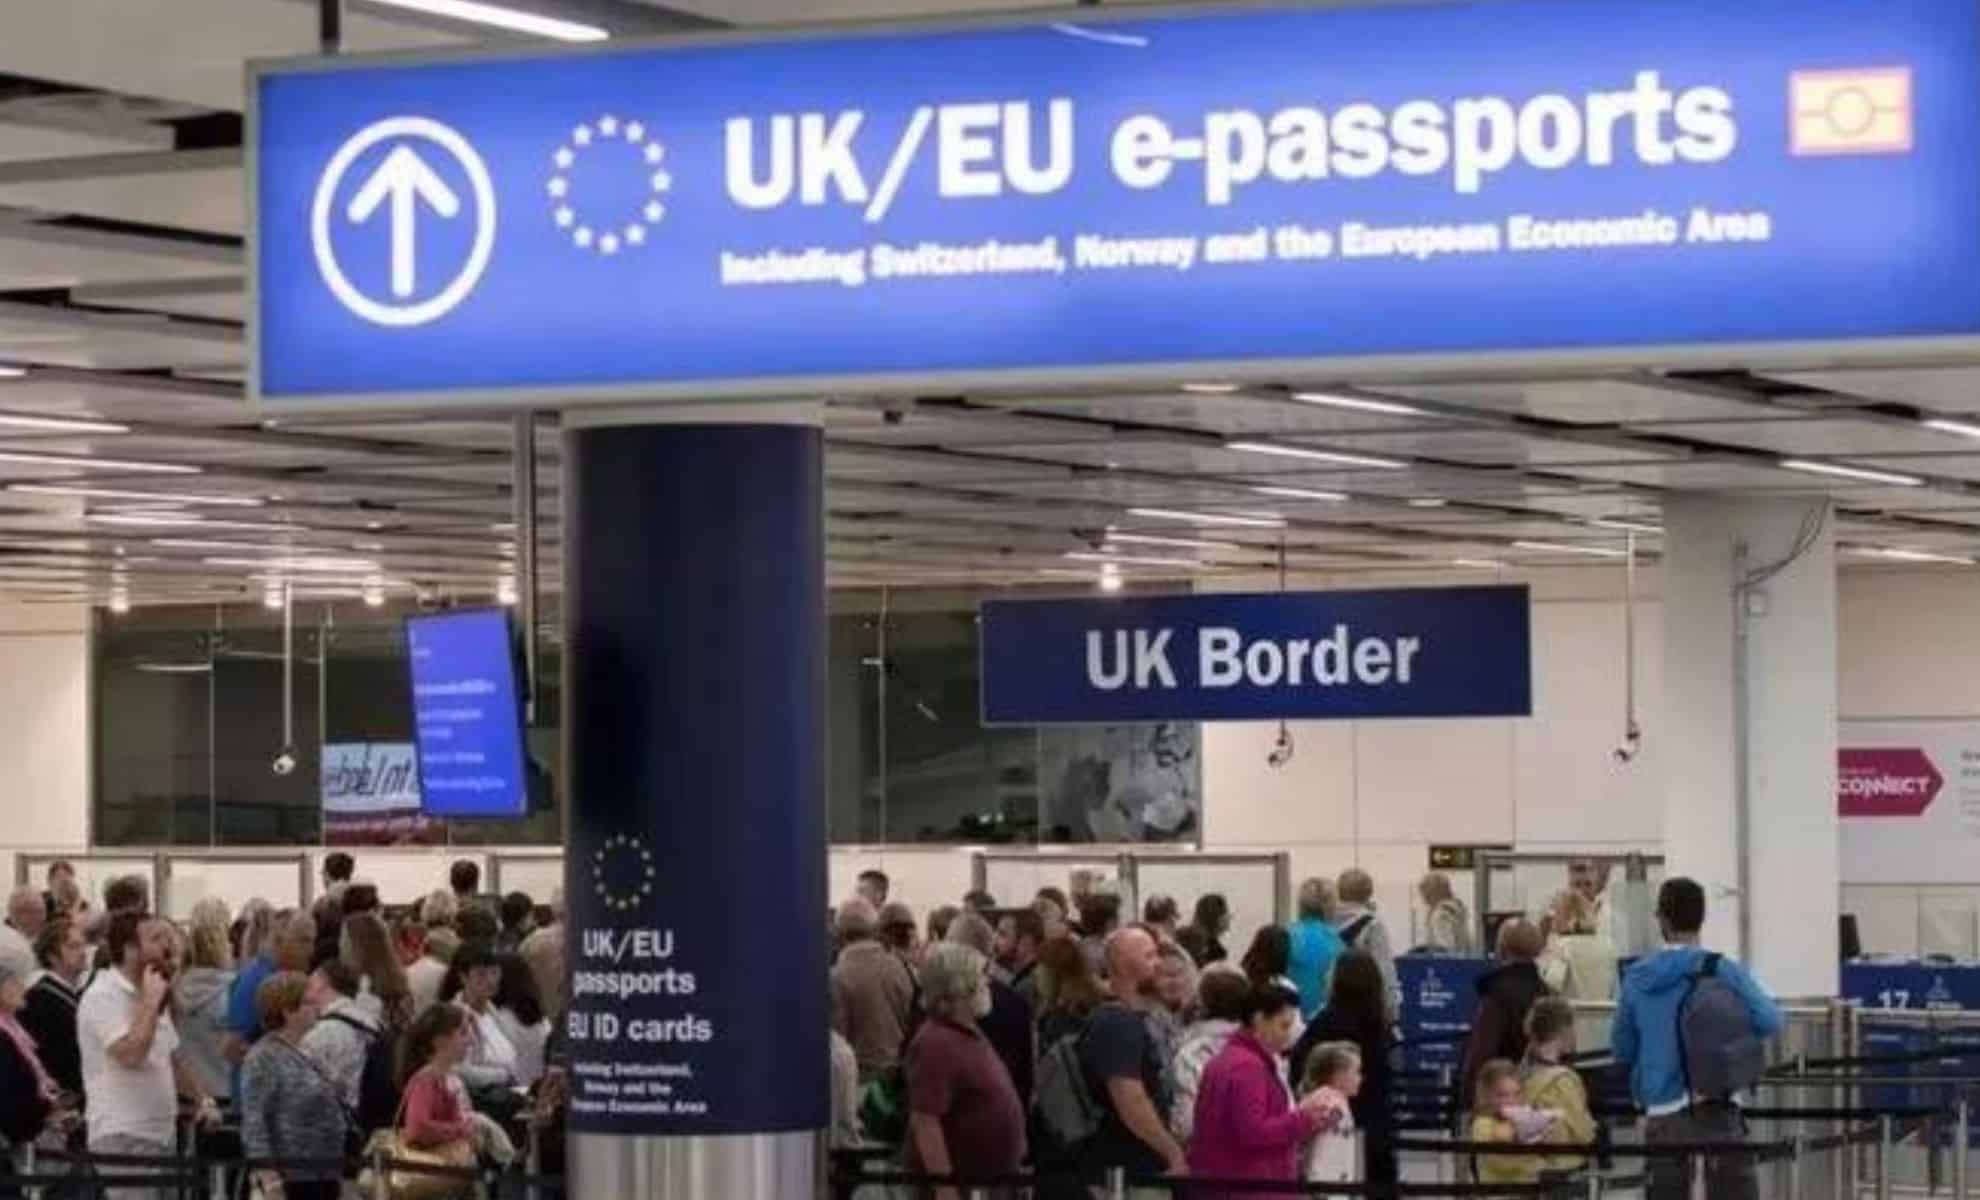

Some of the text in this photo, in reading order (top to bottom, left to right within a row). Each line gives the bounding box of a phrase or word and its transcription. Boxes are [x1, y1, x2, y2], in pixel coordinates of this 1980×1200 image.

[724, 70, 1736, 222] UK/EU e-passports
[720, 208, 1770, 286] Including Switzerland, Norway and the European Economic Area
[1086, 624, 1420, 690] UK Border
[583, 928, 674, 963] UK/EU
[573, 967, 697, 1000] passports
[1878, 989, 1910, 1009] 17
[567, 1010, 713, 1042] EU ID cards
